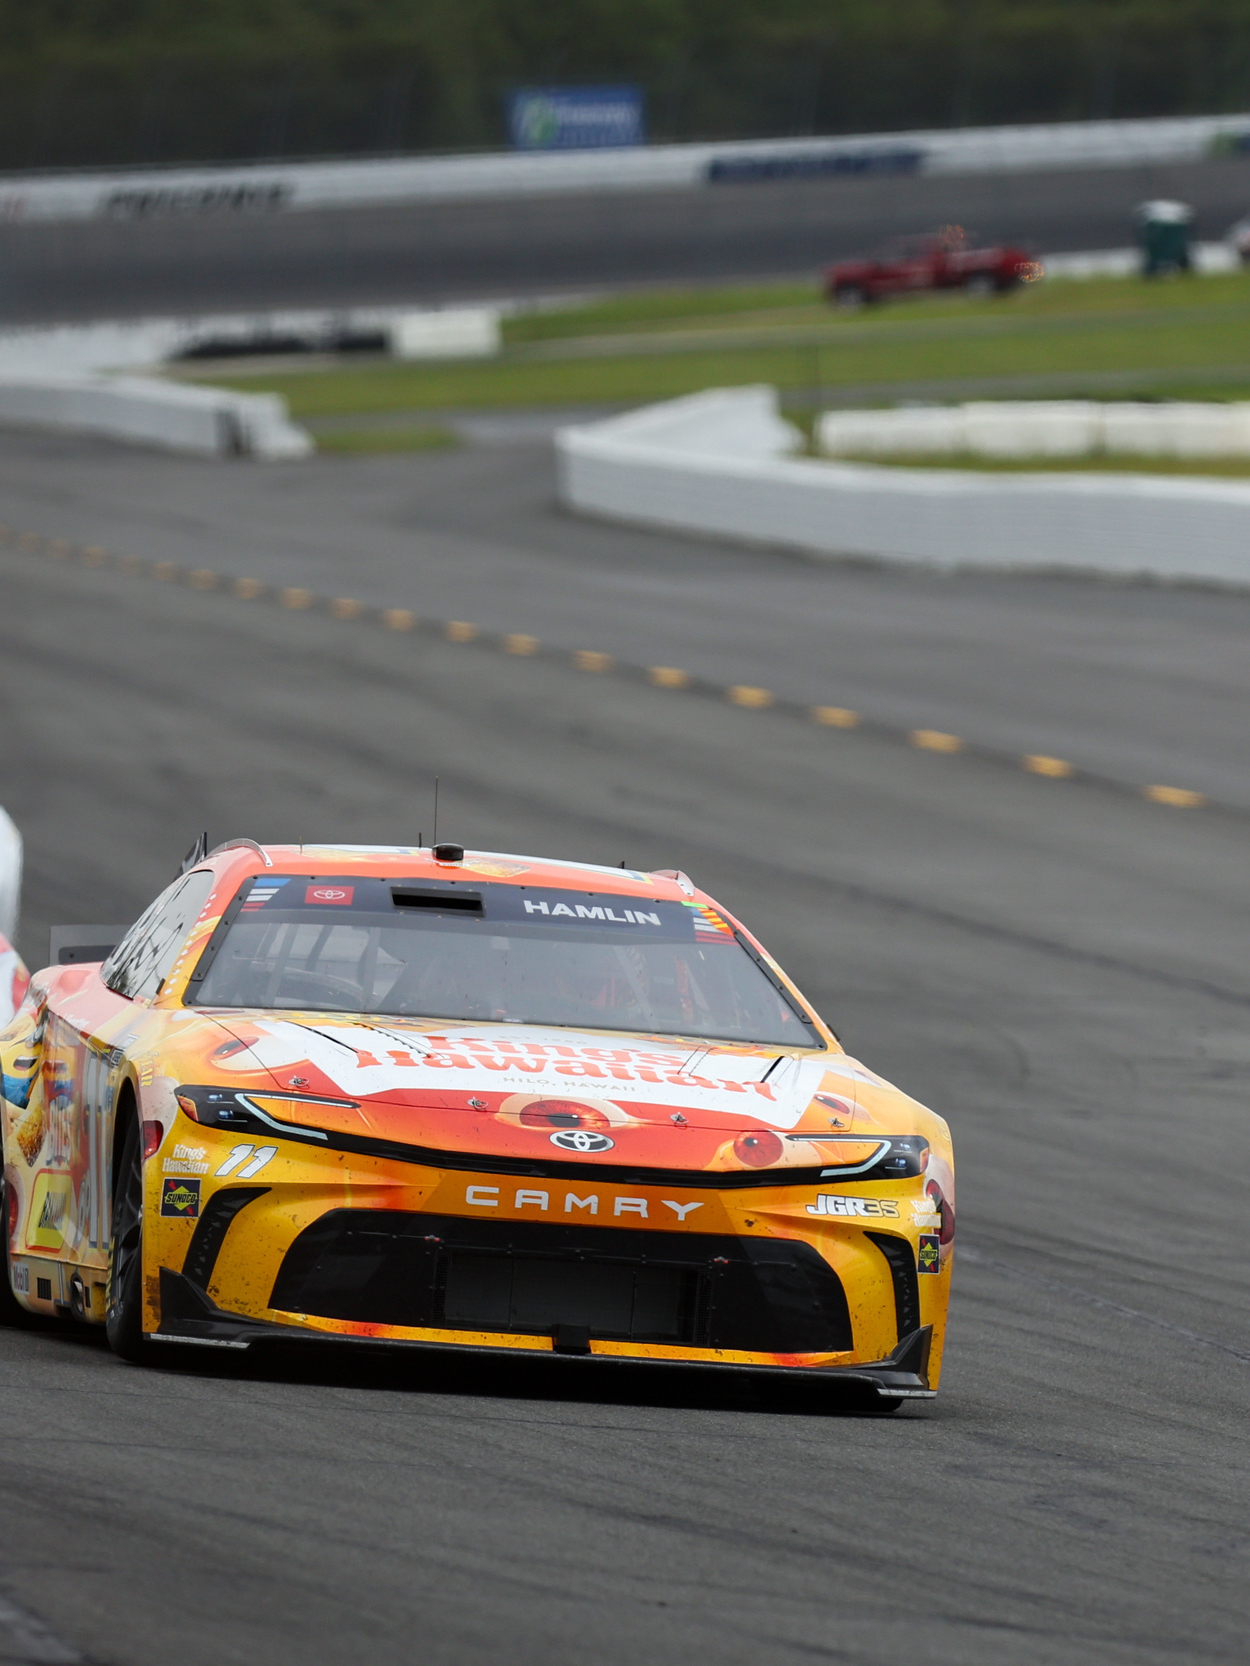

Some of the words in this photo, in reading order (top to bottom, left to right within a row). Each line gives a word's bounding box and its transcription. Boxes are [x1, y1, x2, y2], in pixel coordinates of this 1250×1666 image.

[523, 900, 661, 926] HAMLIN
[423, 1035, 686, 1067] King's
[356, 1049, 778, 1102] Hawaiian
[564, 1080, 636, 1092] HAWAII
[172, 1144, 208, 1161] King's
[213, 1143, 279, 1179] 11
[162, 1157, 210, 1175] Hawaiian
[165, 1193, 197, 1204] SUNOCO
[465, 1185, 705, 1221] CAMRY
